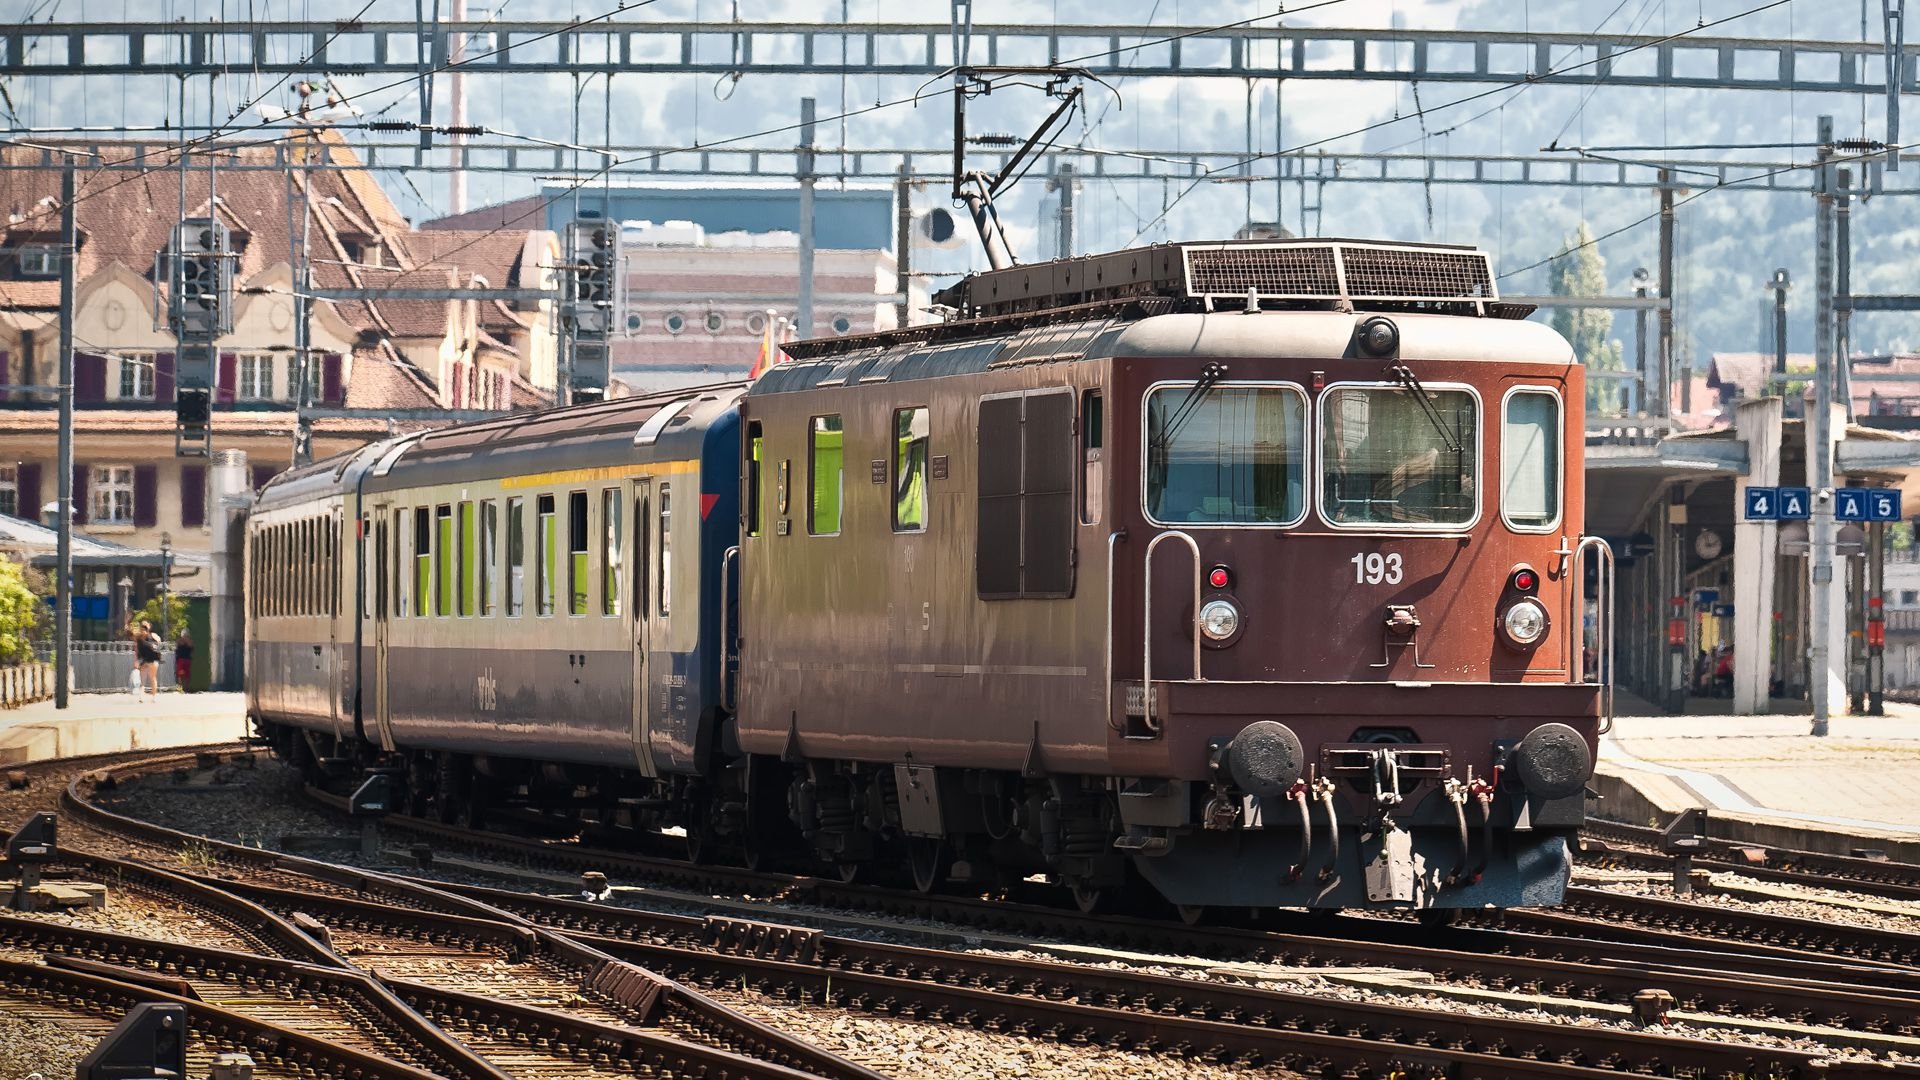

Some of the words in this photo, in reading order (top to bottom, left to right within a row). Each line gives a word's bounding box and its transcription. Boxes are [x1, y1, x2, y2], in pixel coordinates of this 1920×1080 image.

[1754, 496, 1769, 514] 4
[1786, 497, 1802, 514] A
[1844, 498, 1859, 516] A
[1878, 498, 1892, 517] 5
[1351, 552, 1404, 585] 193
